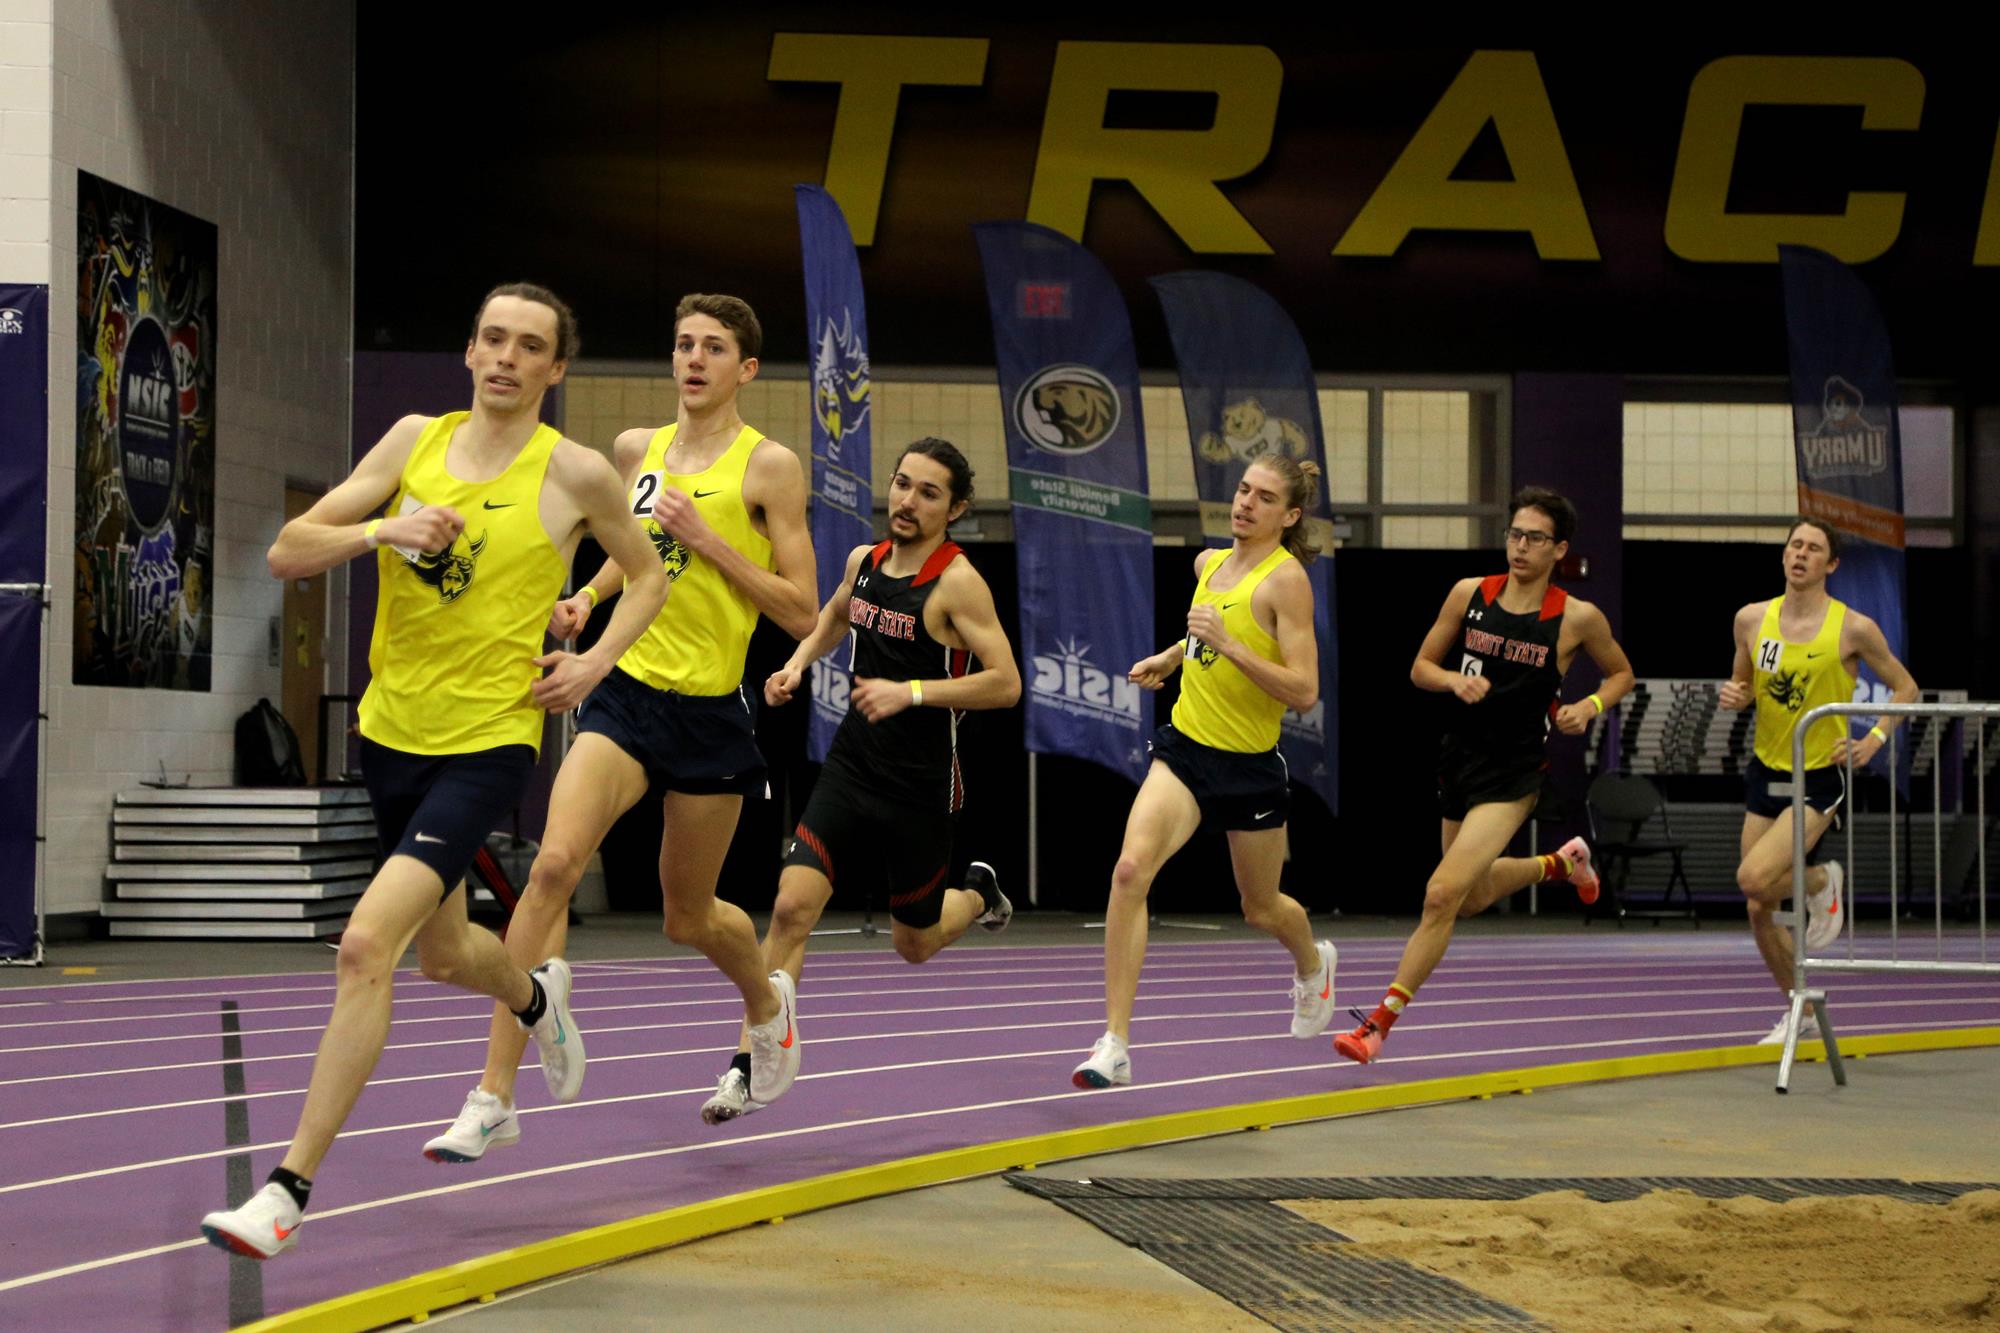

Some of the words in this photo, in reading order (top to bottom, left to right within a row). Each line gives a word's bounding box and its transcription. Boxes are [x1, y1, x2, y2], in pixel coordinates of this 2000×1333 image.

[766, 32, 2000, 266] TRAC
[128, 373, 172, 419] NSIC
[633, 473, 657, 515] 2
[877, 608, 916, 641] STATE
[1504, 639, 1549, 668] STATE
[1761, 640, 1780, 671] 14
